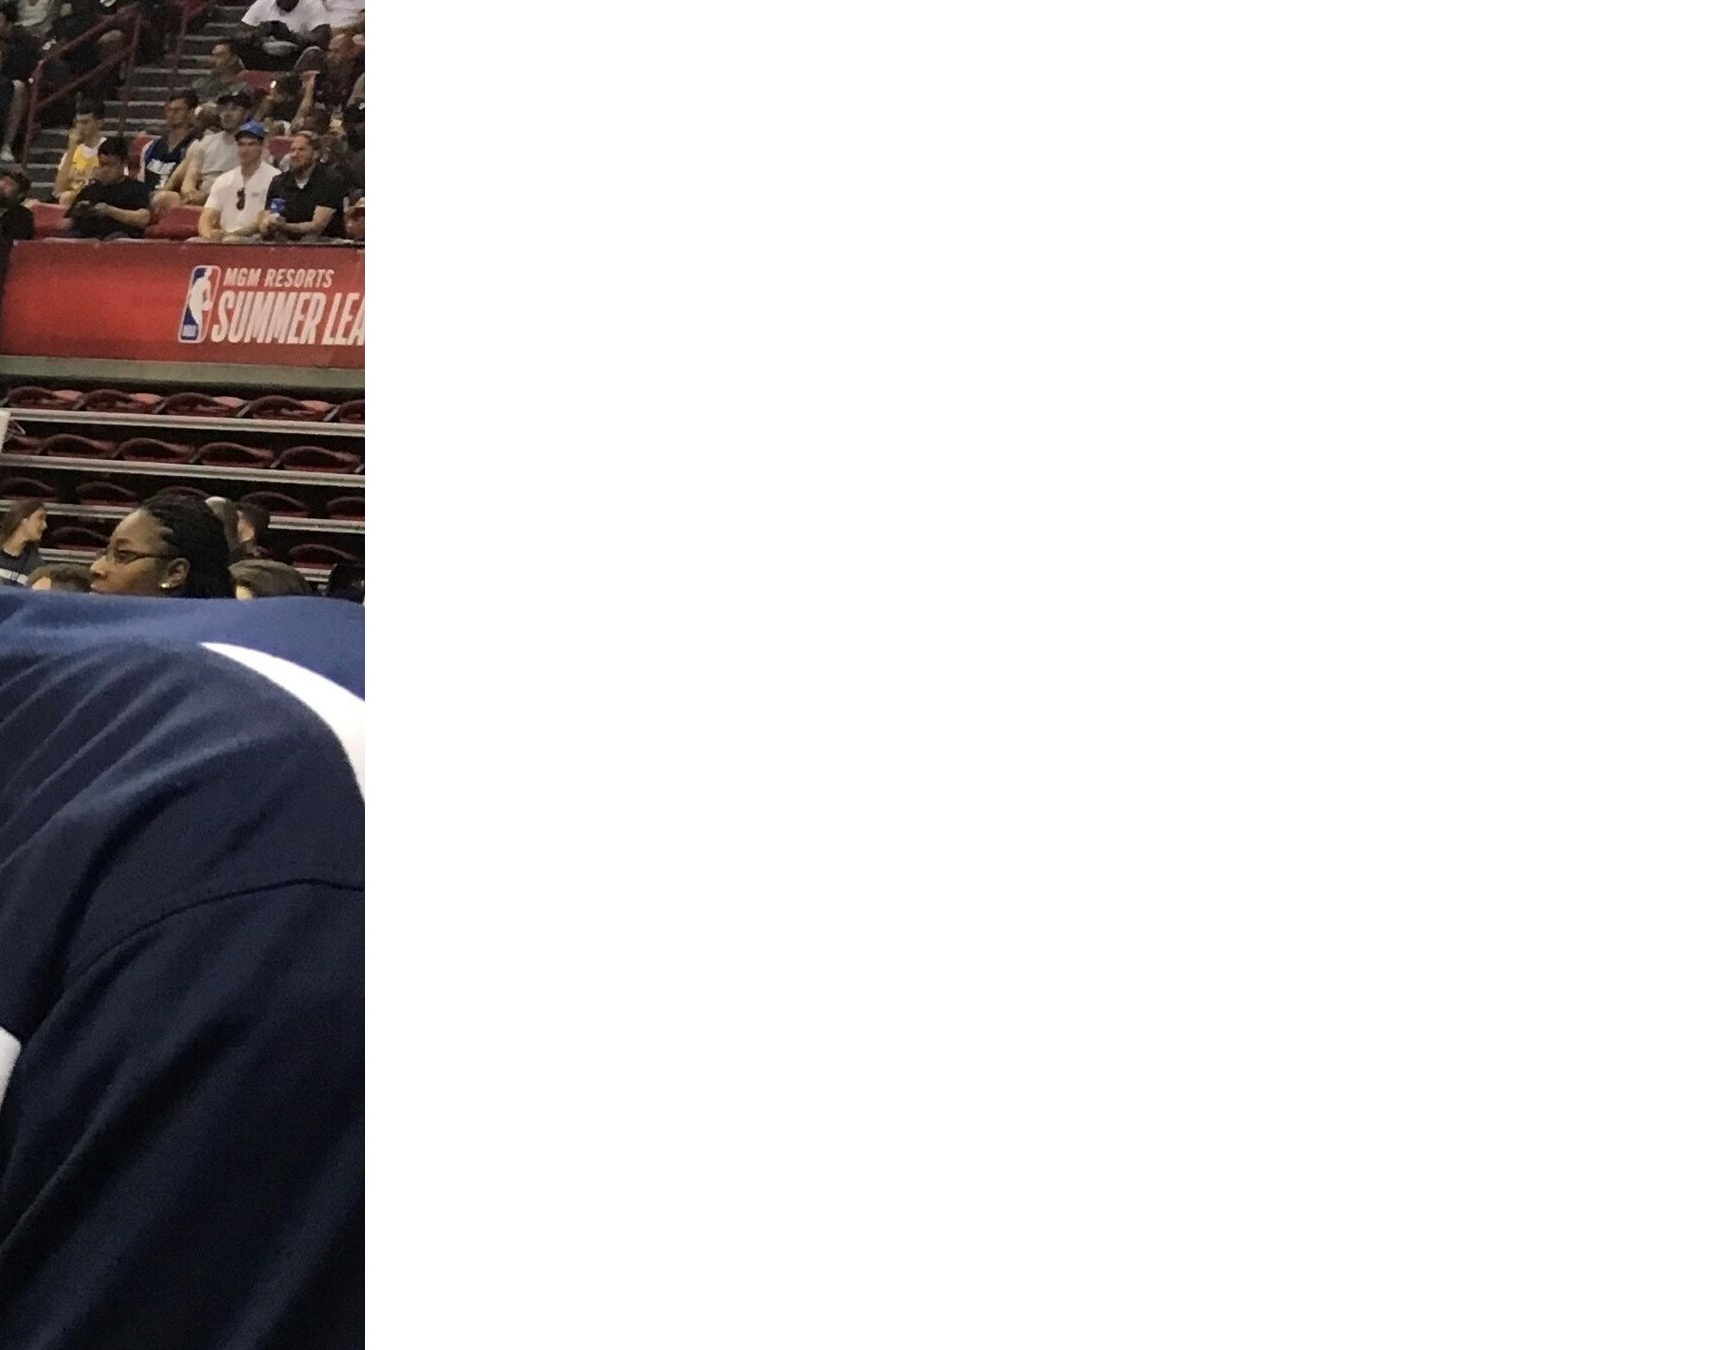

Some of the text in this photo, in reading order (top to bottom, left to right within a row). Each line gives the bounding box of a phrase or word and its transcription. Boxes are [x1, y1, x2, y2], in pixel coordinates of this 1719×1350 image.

[223, 268, 334, 288] MGM RESORTS
[212, 290, 326, 345] SUMMER
